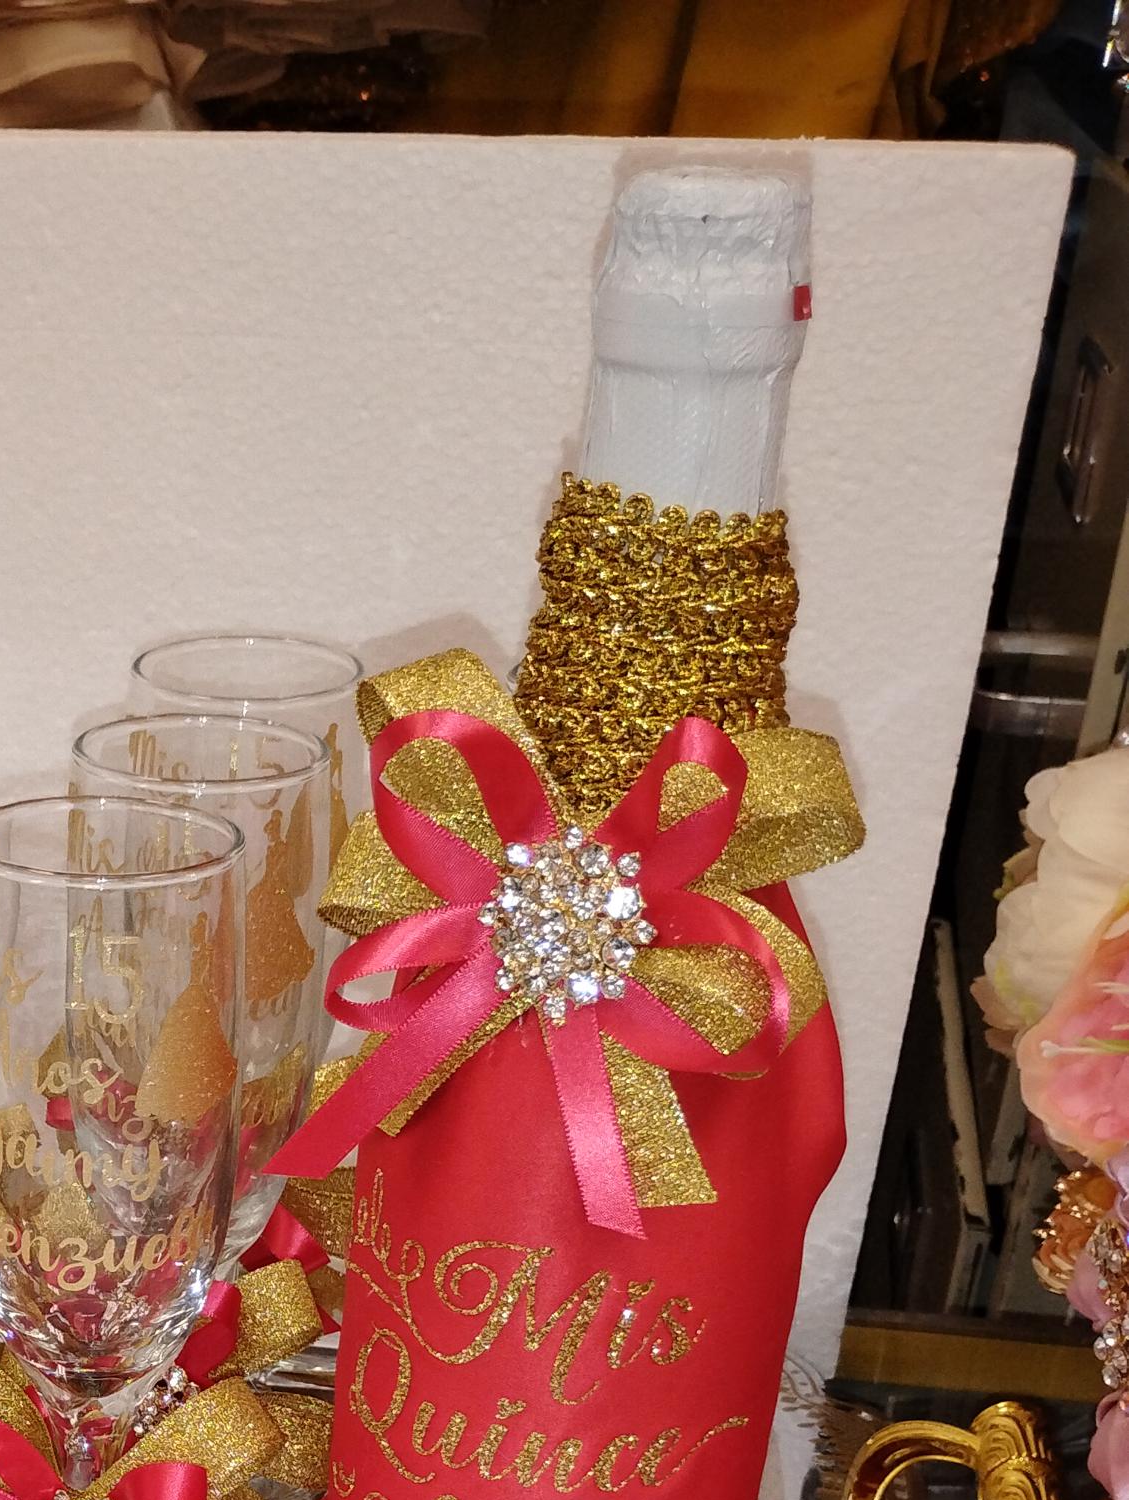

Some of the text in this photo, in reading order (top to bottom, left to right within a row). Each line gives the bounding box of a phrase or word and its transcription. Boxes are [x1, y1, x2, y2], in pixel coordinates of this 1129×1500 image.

[65, 934, 144, 1025] 15
[371, 1238, 709, 1406] Mis
[349, 1325, 750, 1494] Quince
